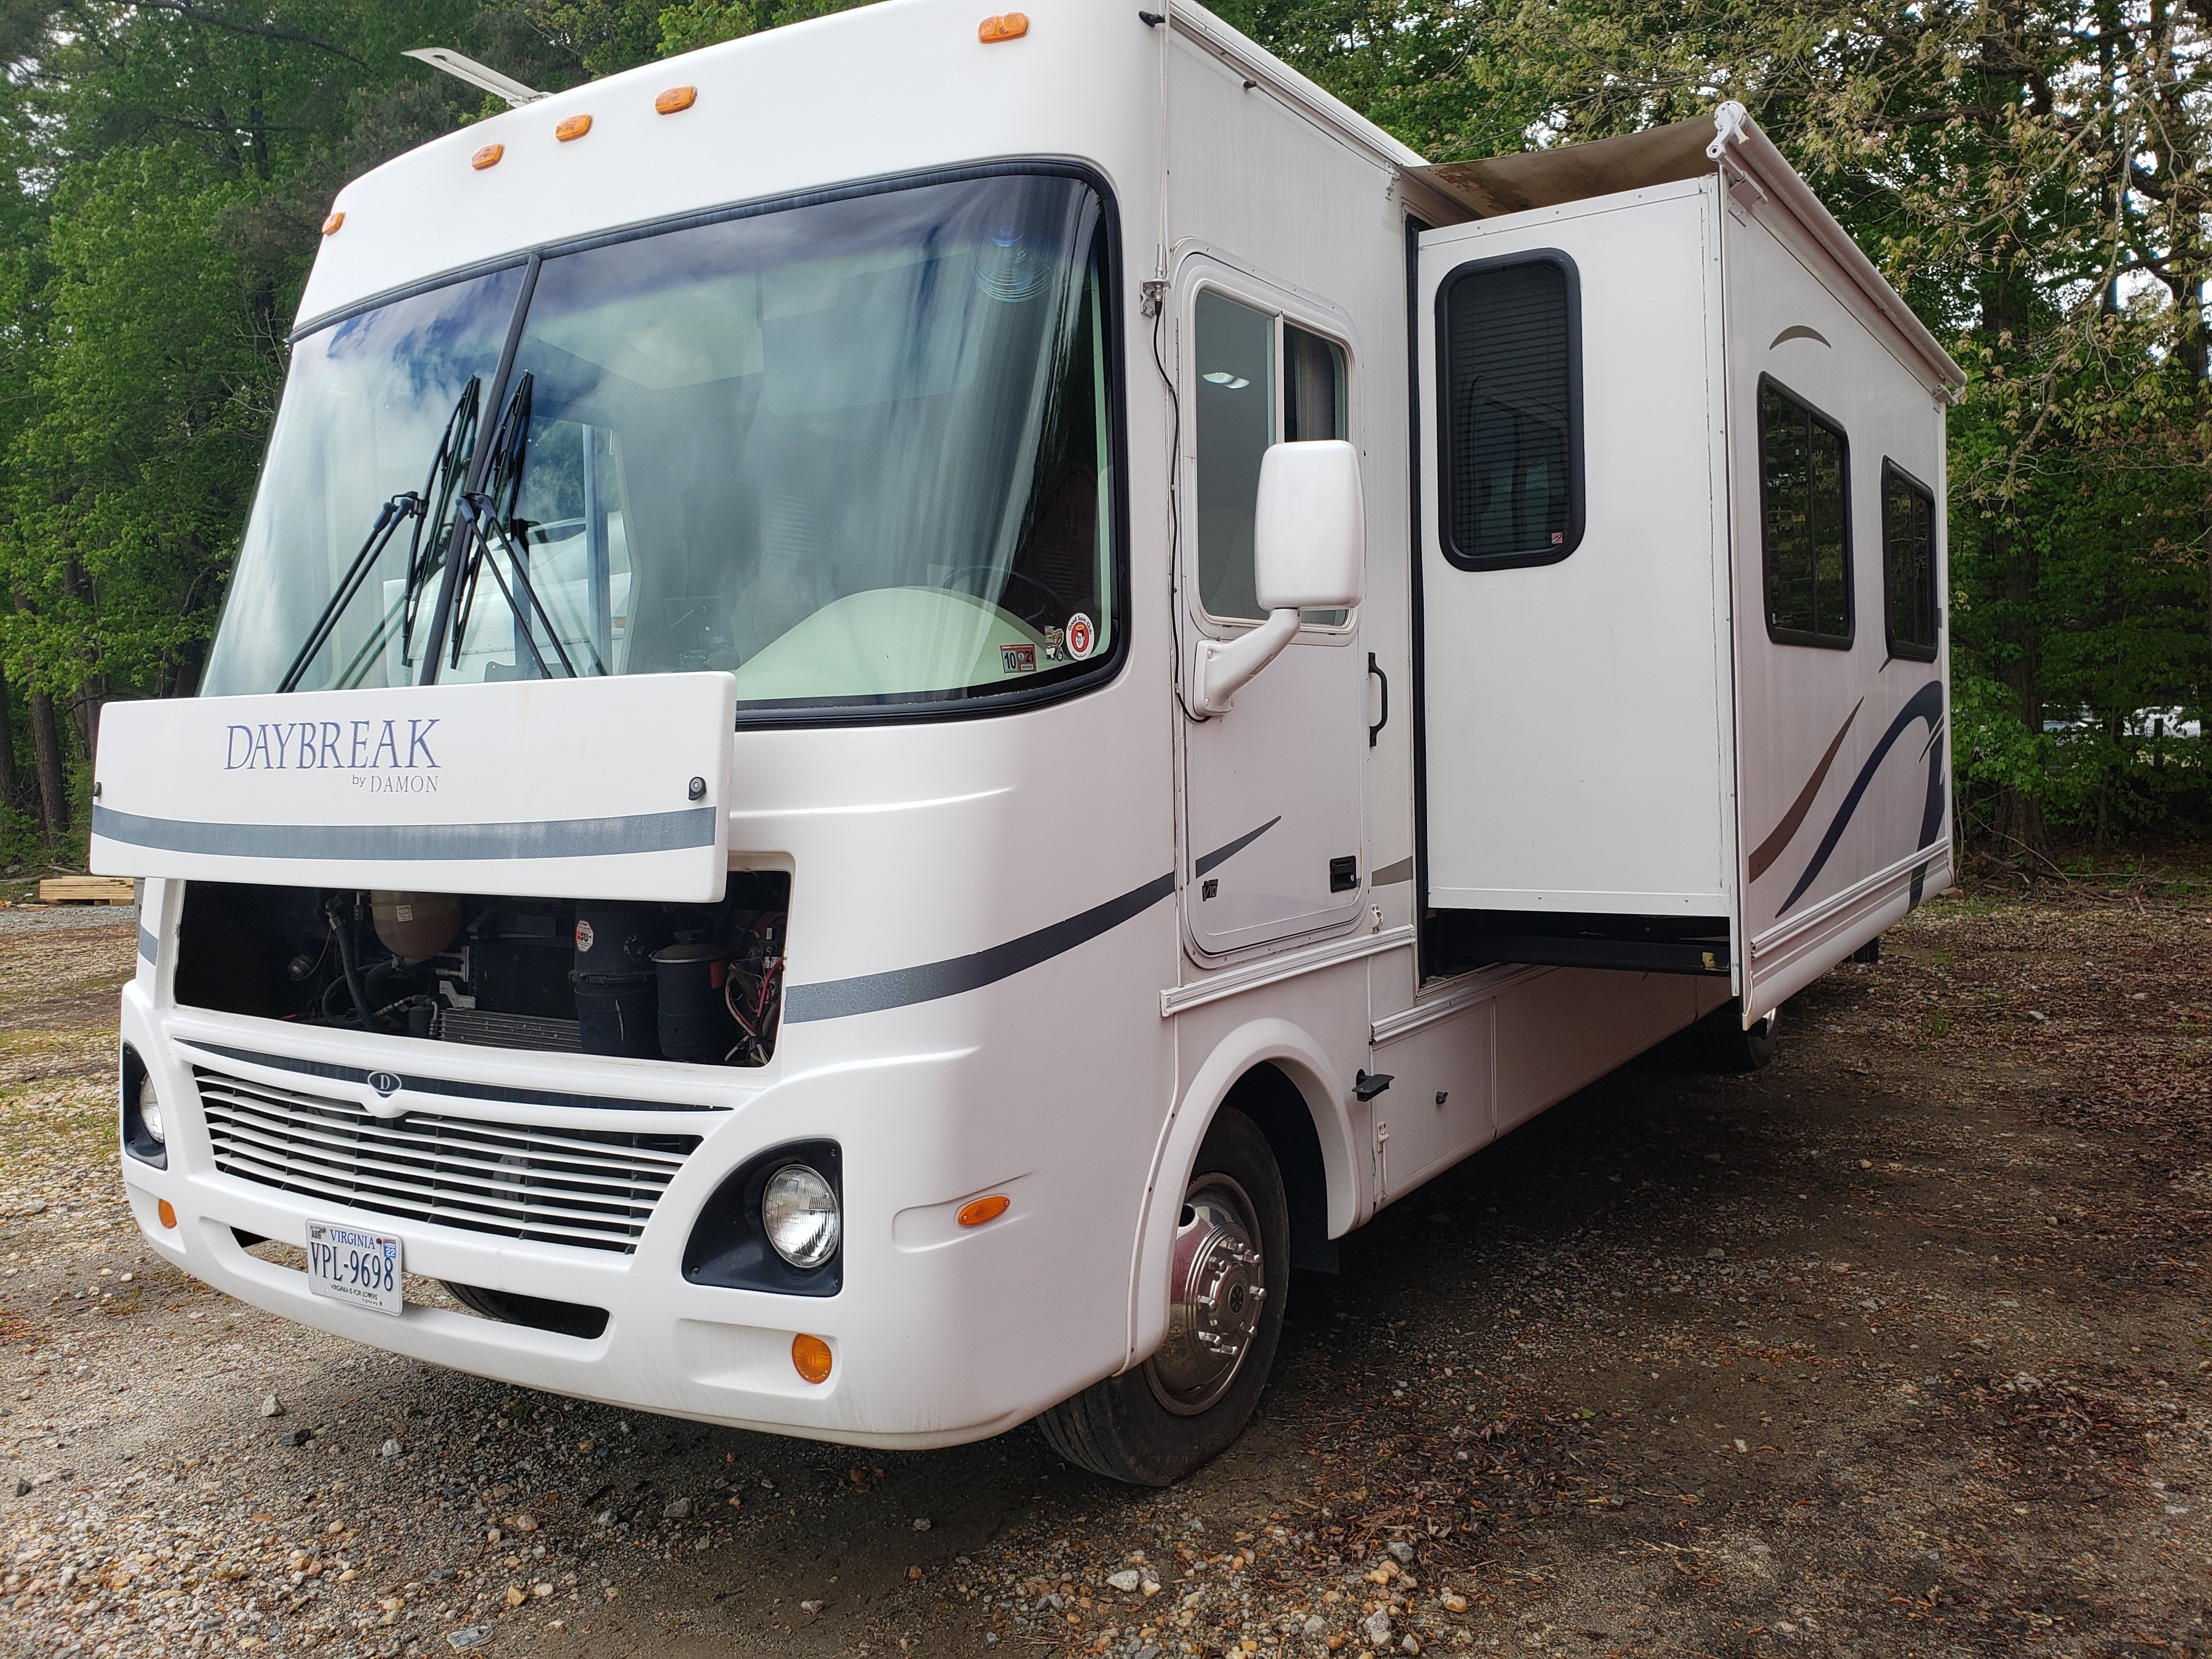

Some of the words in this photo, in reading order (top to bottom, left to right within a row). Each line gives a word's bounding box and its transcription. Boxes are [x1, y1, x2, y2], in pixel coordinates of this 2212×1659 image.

[1068, 616, 1077, 631] Good
[1077, 615, 1086, 623] Sam
[1005, 652, 1016, 669] 10
[1025, 650, 1034, 663] 21
[224, 719, 441, 770] DAYBREAK
[352, 774, 366, 787] by
[370, 775, 439, 793] DAMON
[1203, 885, 1217, 901] V10
[380, 1075, 390, 1090] D
[312, 1230, 321, 1239] AUG
[330, 1229, 376, 1250] VIRGINIA
[386, 1248, 396, 1257] 22
[310, 1242, 393, 1291] VPL-9698
[330, 1284, 349, 1293] VIRGINIA
